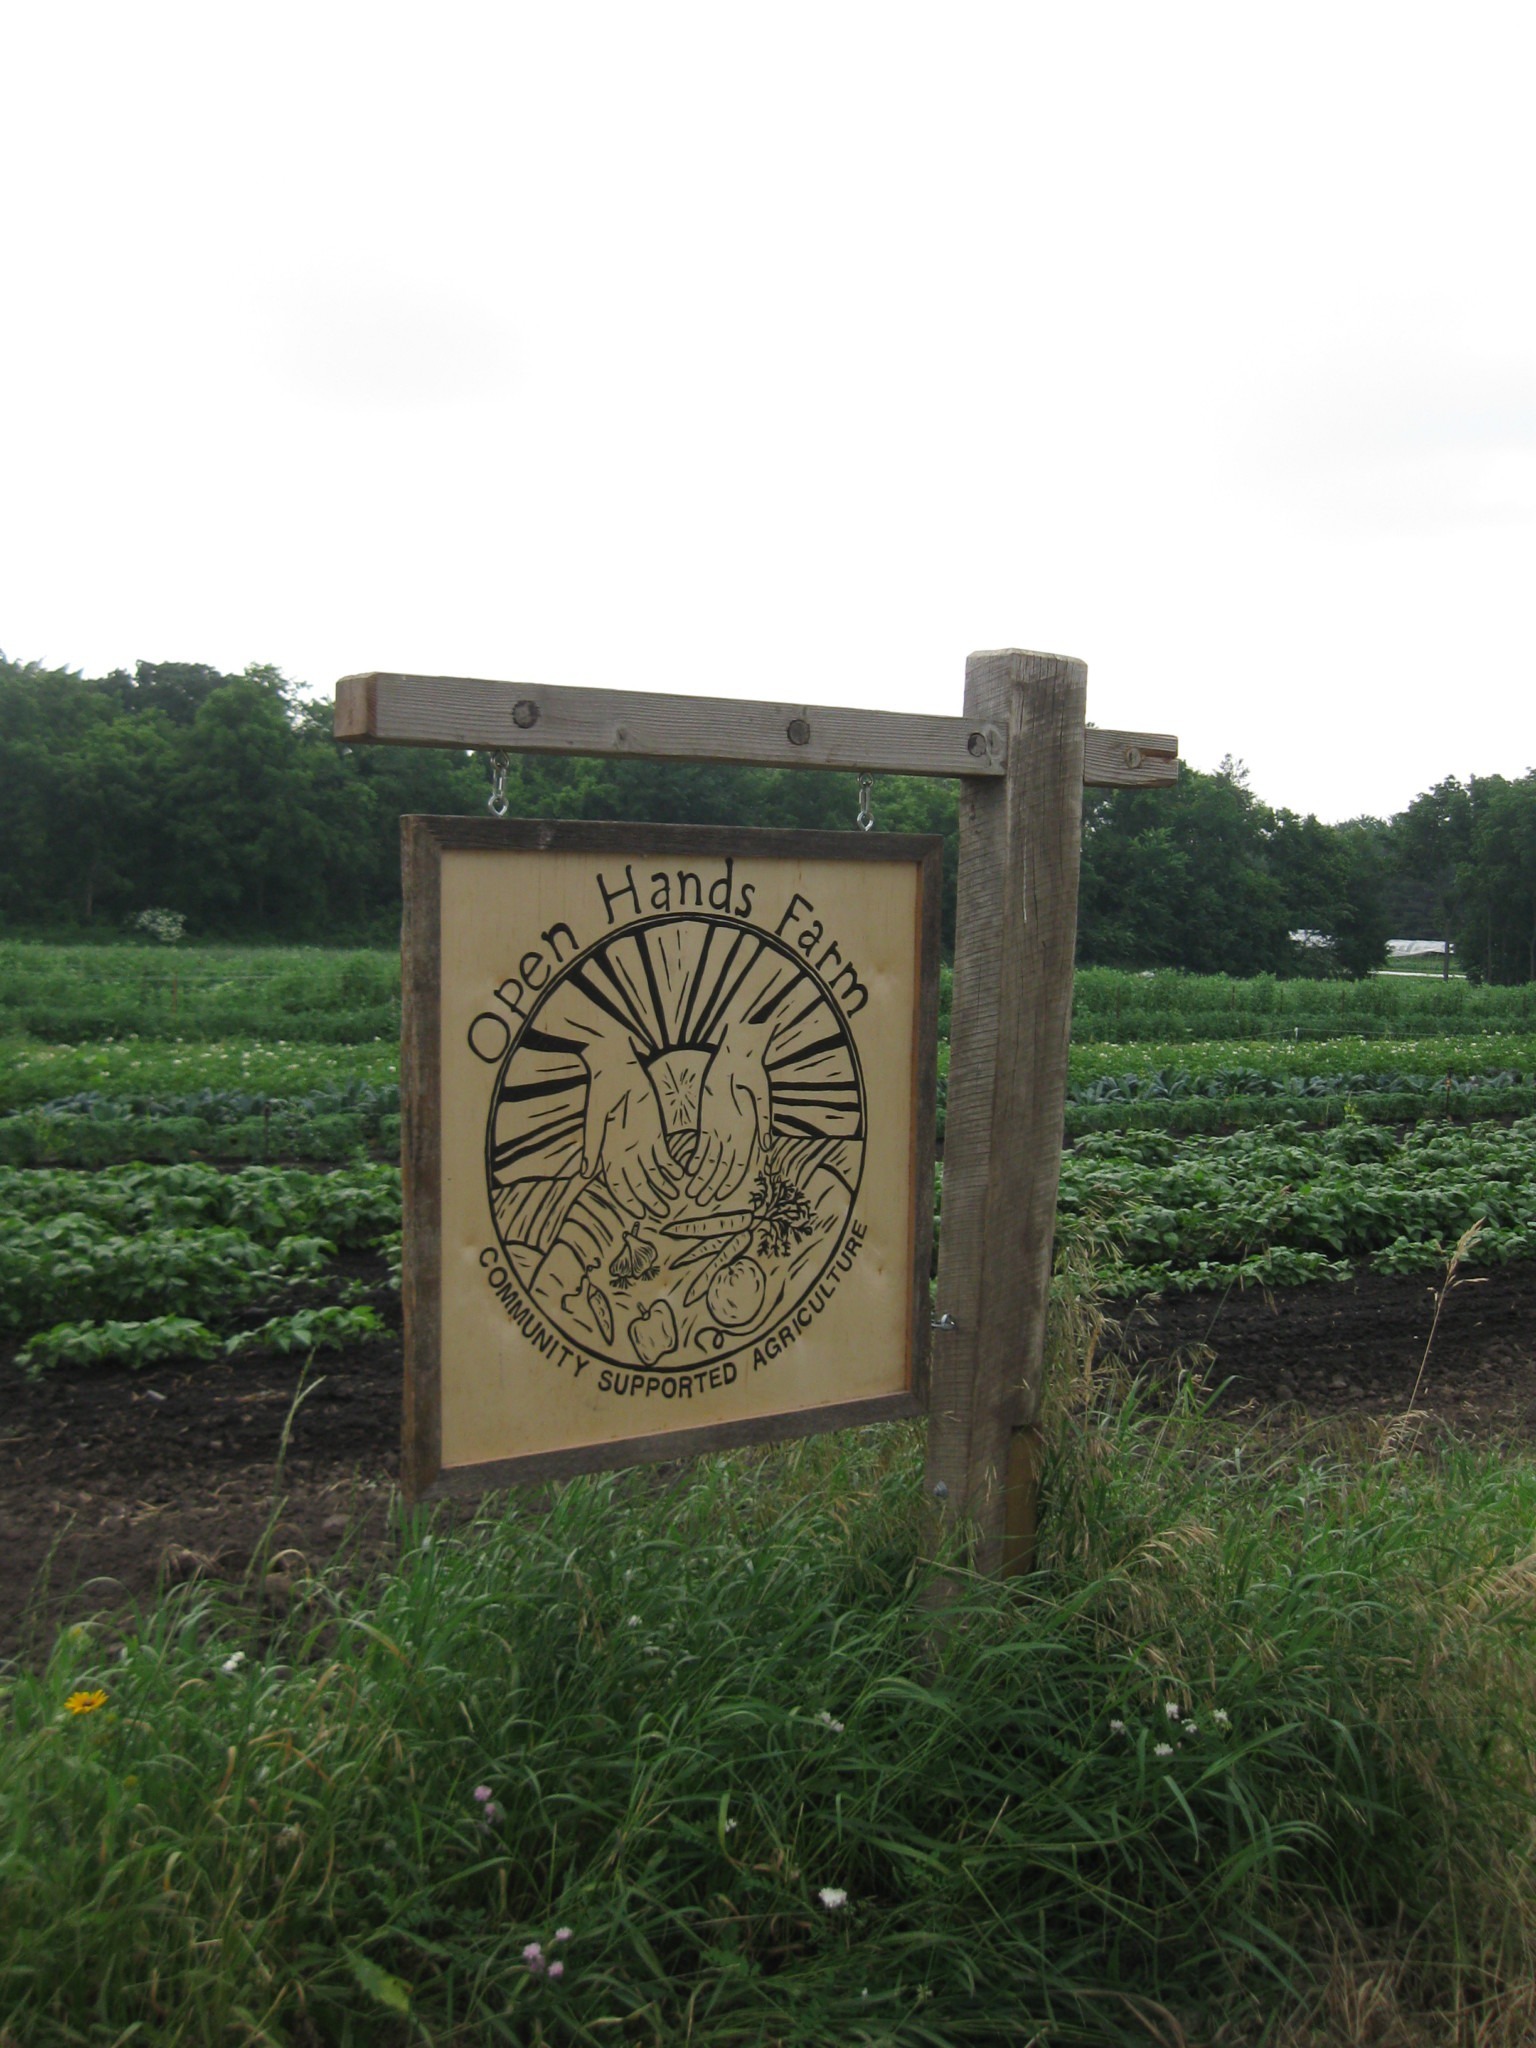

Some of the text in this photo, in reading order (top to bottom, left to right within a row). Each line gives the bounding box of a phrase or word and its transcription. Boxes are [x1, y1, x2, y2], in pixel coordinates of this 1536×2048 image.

[467, 856, 869, 1064] Open Hands Farm
[478, 1219, 868, 1399] COMMUNITY SUPPORTED AGRICULTURE
